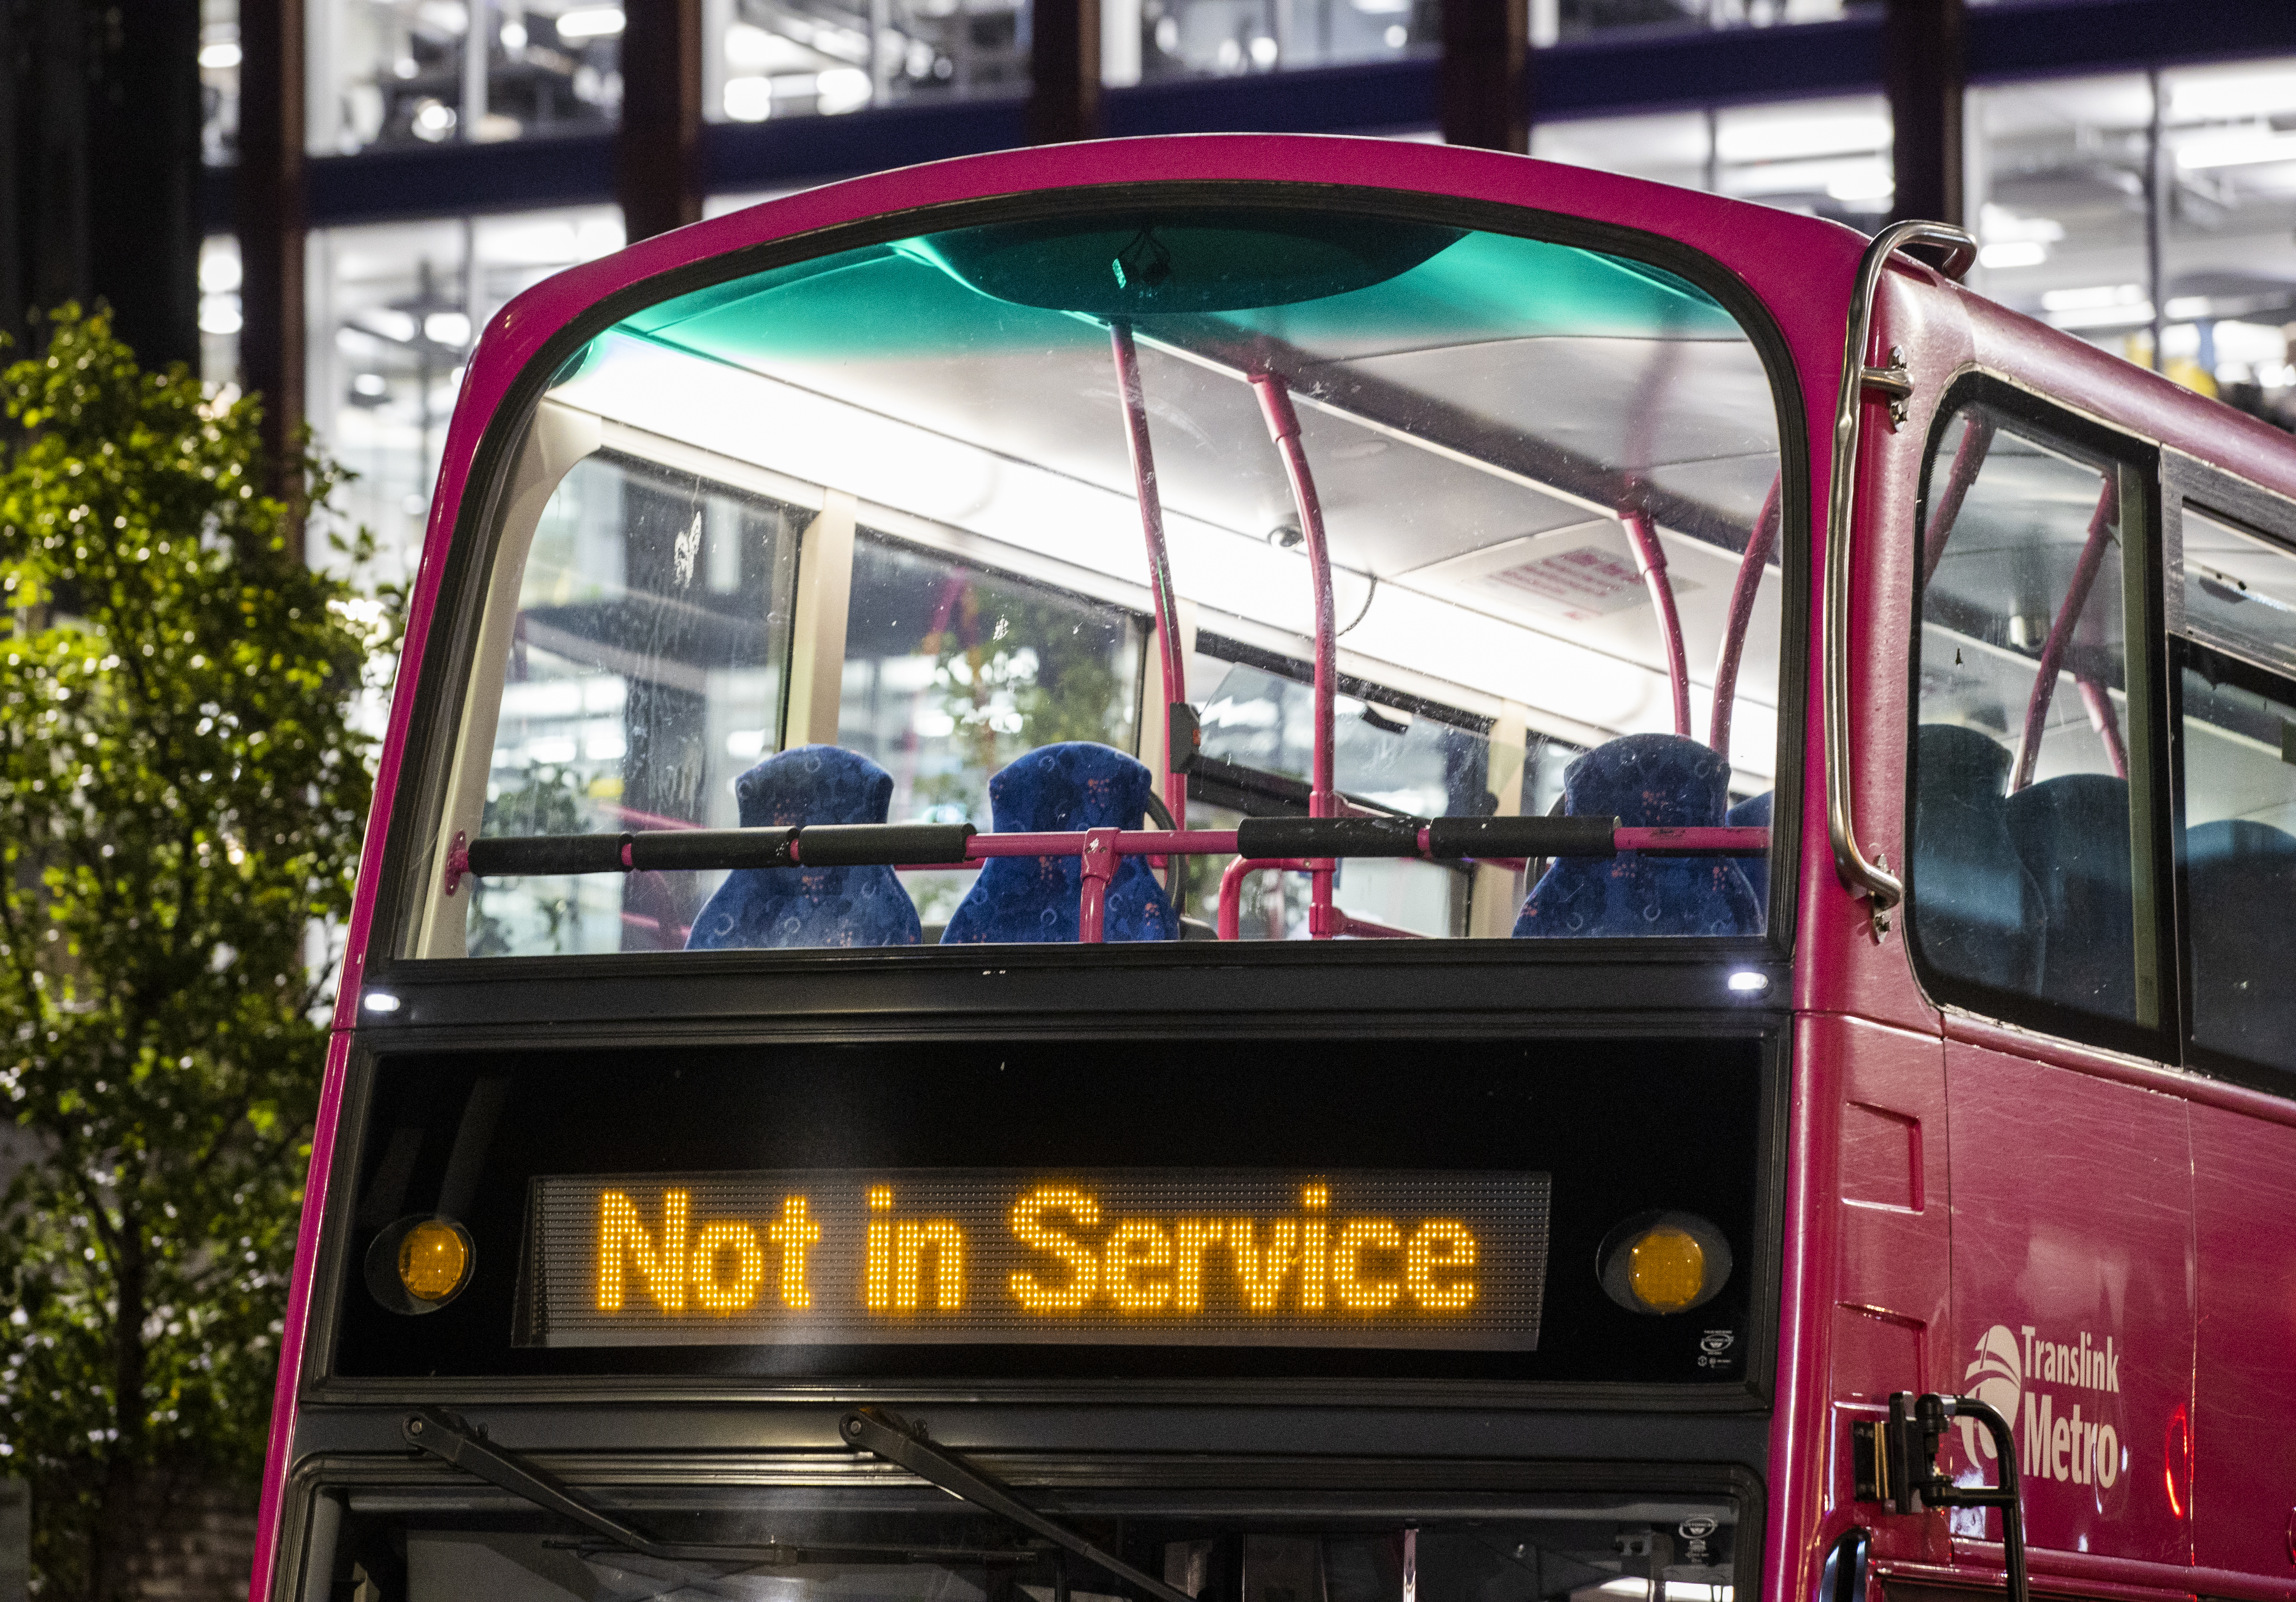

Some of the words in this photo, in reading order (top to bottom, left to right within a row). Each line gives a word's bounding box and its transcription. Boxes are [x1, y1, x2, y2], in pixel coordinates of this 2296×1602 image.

[598, 1190, 820, 1310] Not
[866, 1186, 962, 1310] in
[1011, 1186, 1476, 1310] Service
[2022, 1325, 2119, 1393] Translink
[2024, 1392, 2118, 1488] Metro
